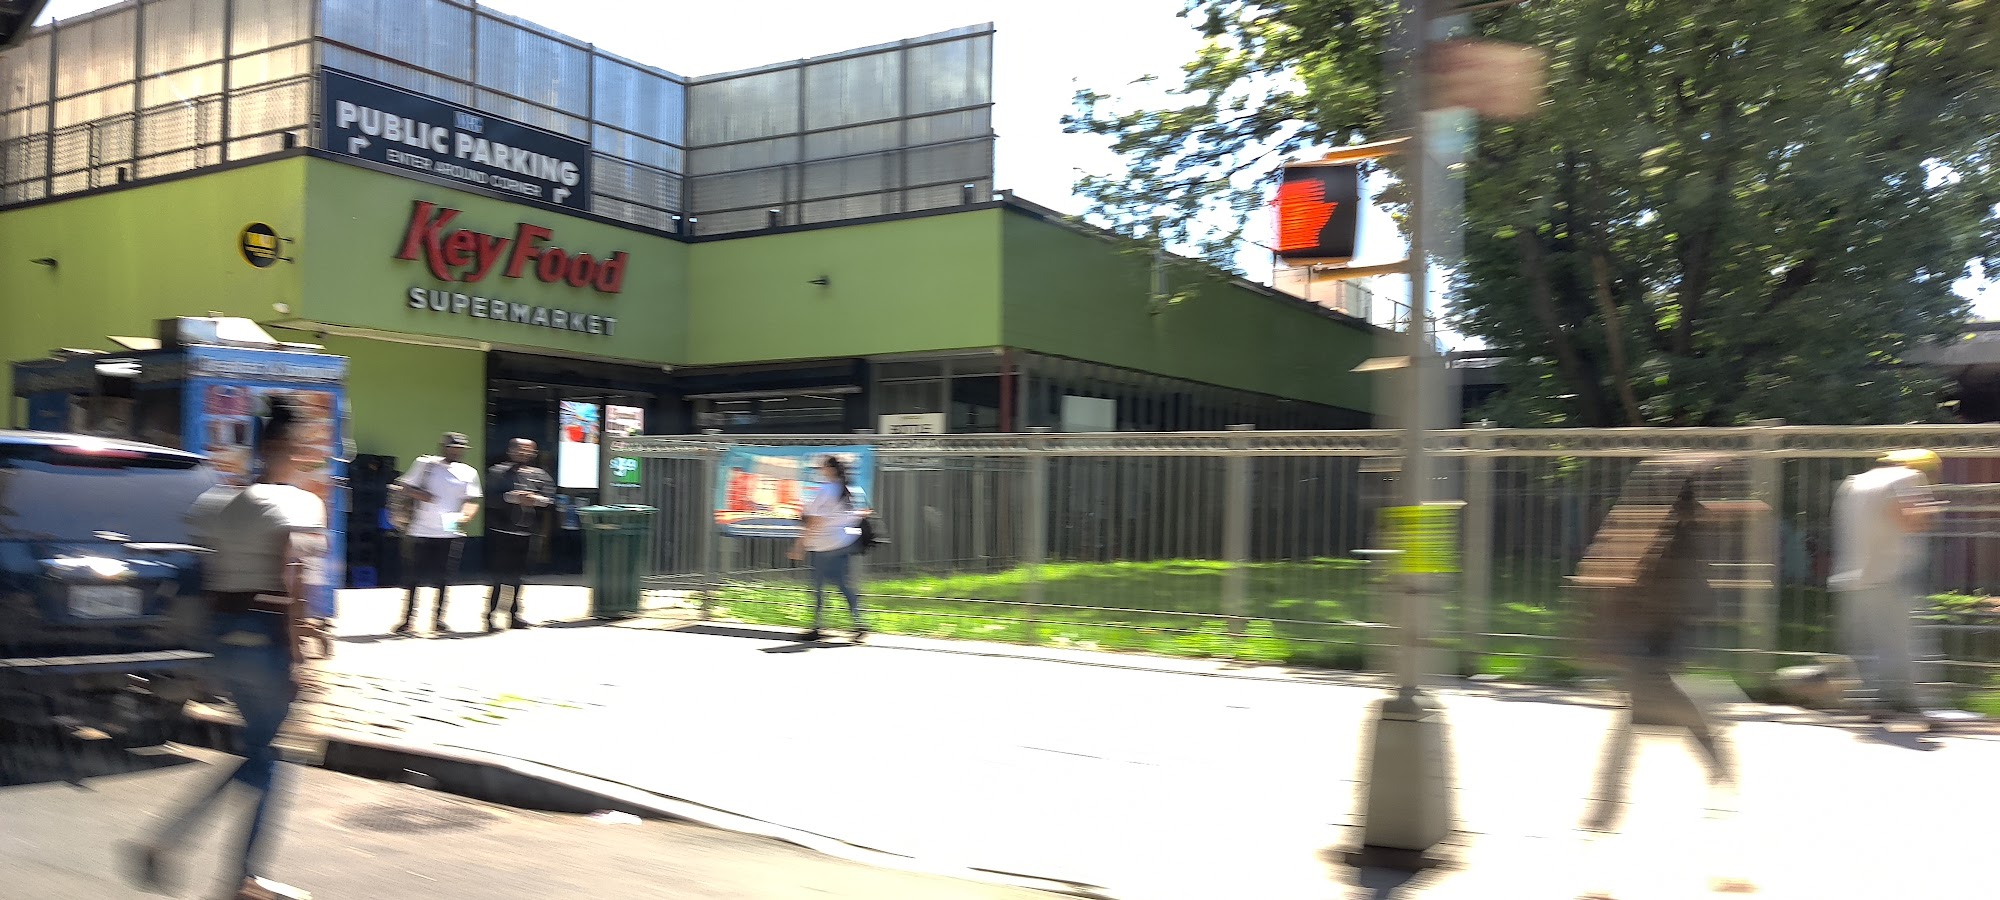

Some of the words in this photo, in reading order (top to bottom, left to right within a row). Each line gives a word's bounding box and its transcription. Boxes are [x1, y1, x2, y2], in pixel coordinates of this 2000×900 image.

[336, 100, 449, 154] PUBLIC
[455, 132, 580, 186] PARKING
[386, 149, 433, 170] ENTER
[434, 161, 489, 184] AROUND
[489, 175, 542, 197] CORNER
[395, 200, 510, 282] Key
[501, 223, 629, 293] Food
[409, 287, 618, 336] SUPERMARKET
